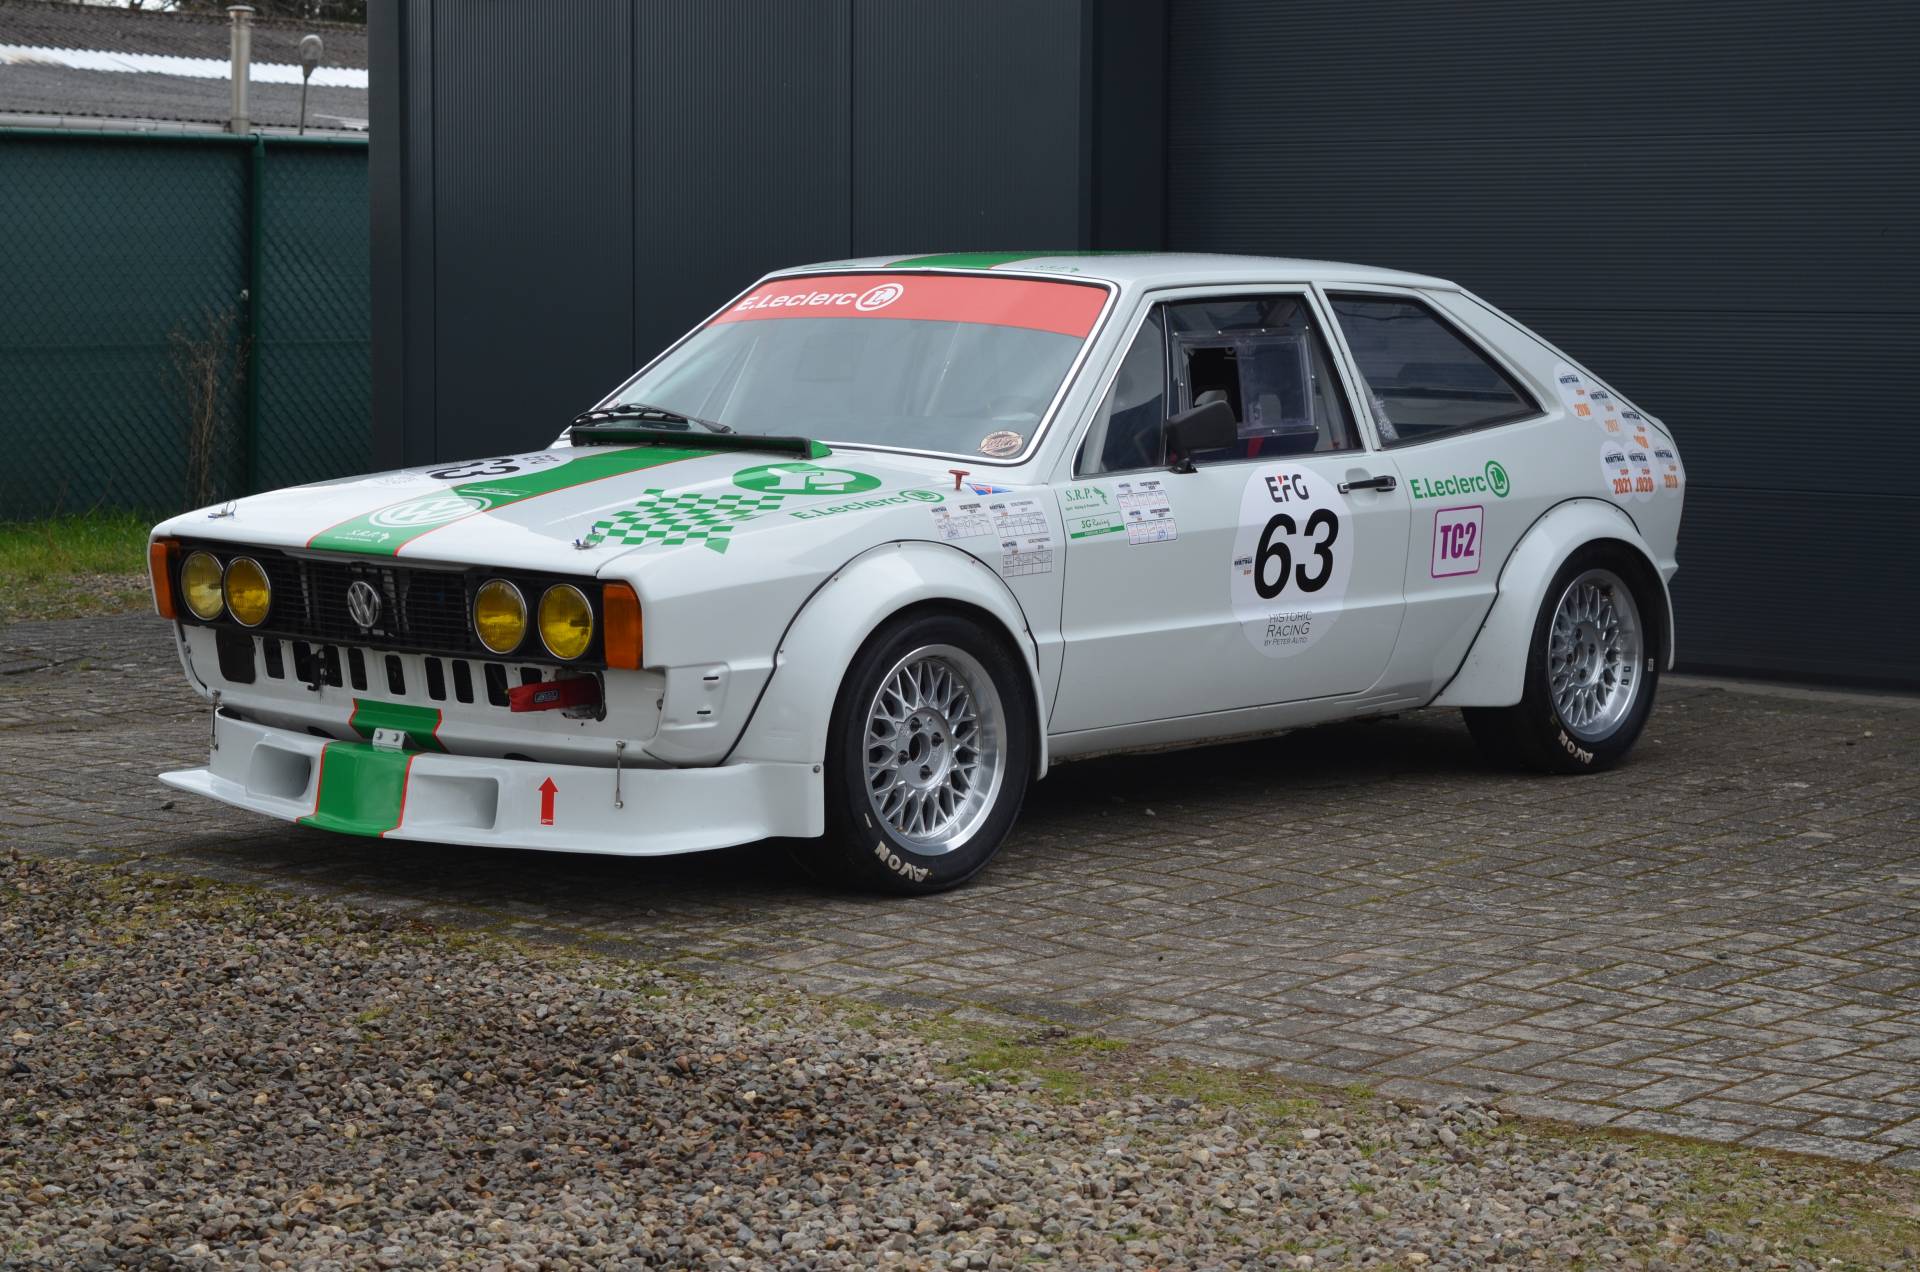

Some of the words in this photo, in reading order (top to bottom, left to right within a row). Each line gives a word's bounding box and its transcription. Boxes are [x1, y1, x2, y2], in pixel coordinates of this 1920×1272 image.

[734, 290, 858, 312] E.Leclerc
[1265, 474, 1310, 503] EFG
[1409, 474, 1487, 499] E.Leclerc
[788, 495, 909, 520] E.Leclerc
[1254, 508, 1339, 599] 63
[1440, 521, 1477, 560] TC2
[1266, 621, 1311, 638] RACING
[1558, 729, 1594, 765] AVON
[874, 840, 930, 882] AVON
